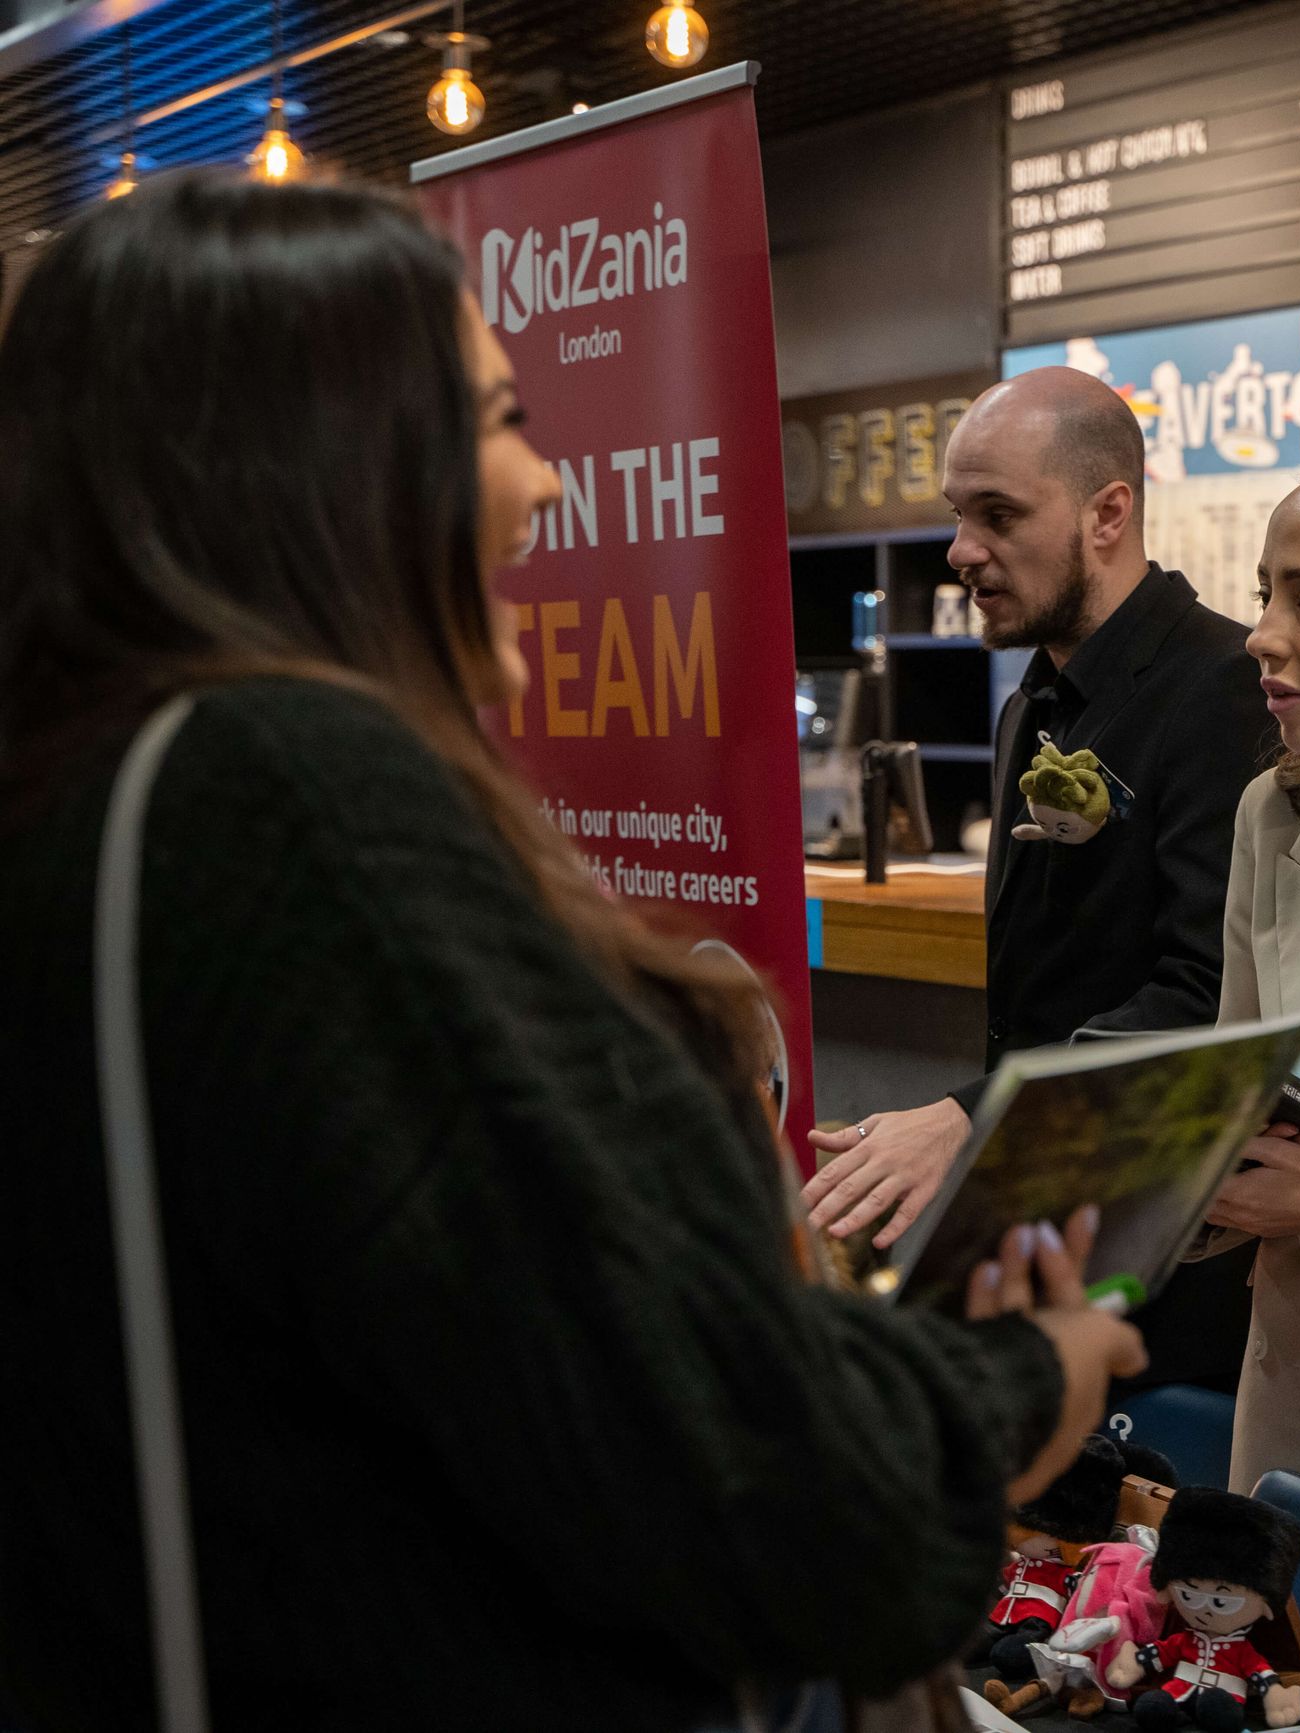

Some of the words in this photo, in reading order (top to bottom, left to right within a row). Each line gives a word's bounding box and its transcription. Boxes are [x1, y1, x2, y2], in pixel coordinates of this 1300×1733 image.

[481, 202, 688, 334] KidZania
[559, 325, 622, 365] London
[611, 437, 725, 544] THE
[559, 798, 577, 835] in
[581, 807, 612, 838] our
[616, 801, 682, 848] unique
[686, 803, 727, 852] city,
[614, 856, 676, 899] future
[680, 872, 759, 906] careers
